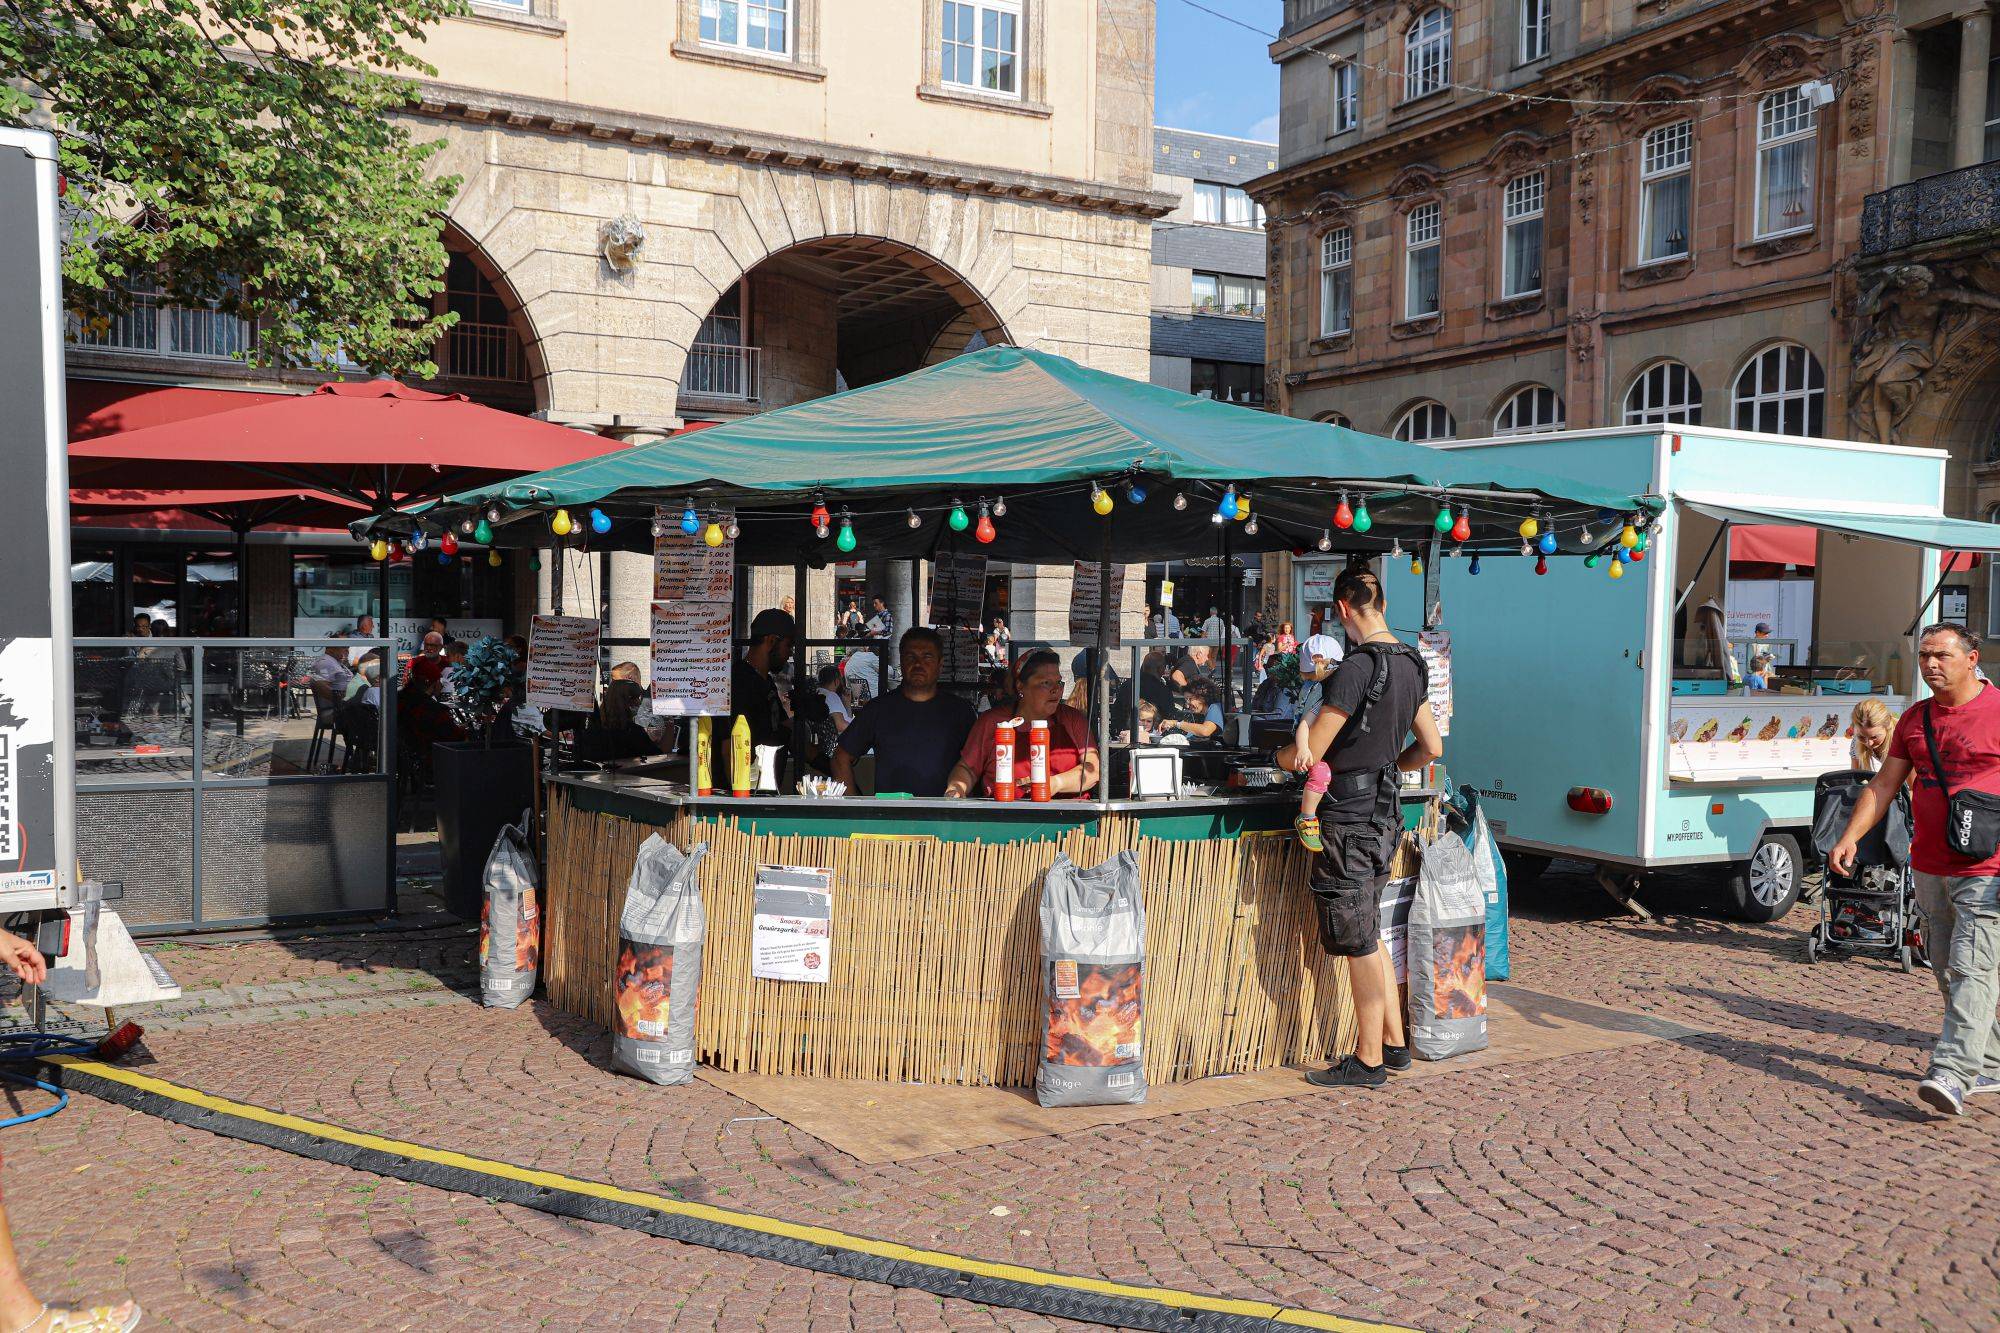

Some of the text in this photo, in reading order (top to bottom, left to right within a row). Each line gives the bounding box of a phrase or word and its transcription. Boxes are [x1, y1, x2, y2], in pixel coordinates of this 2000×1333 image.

[1736, 611, 1772, 619] Vermieten
[1960, 809, 1973, 846] adidas
[0, 878, 46, 889] ightherm
[1051, 1077, 1073, 1090] 10 kg
